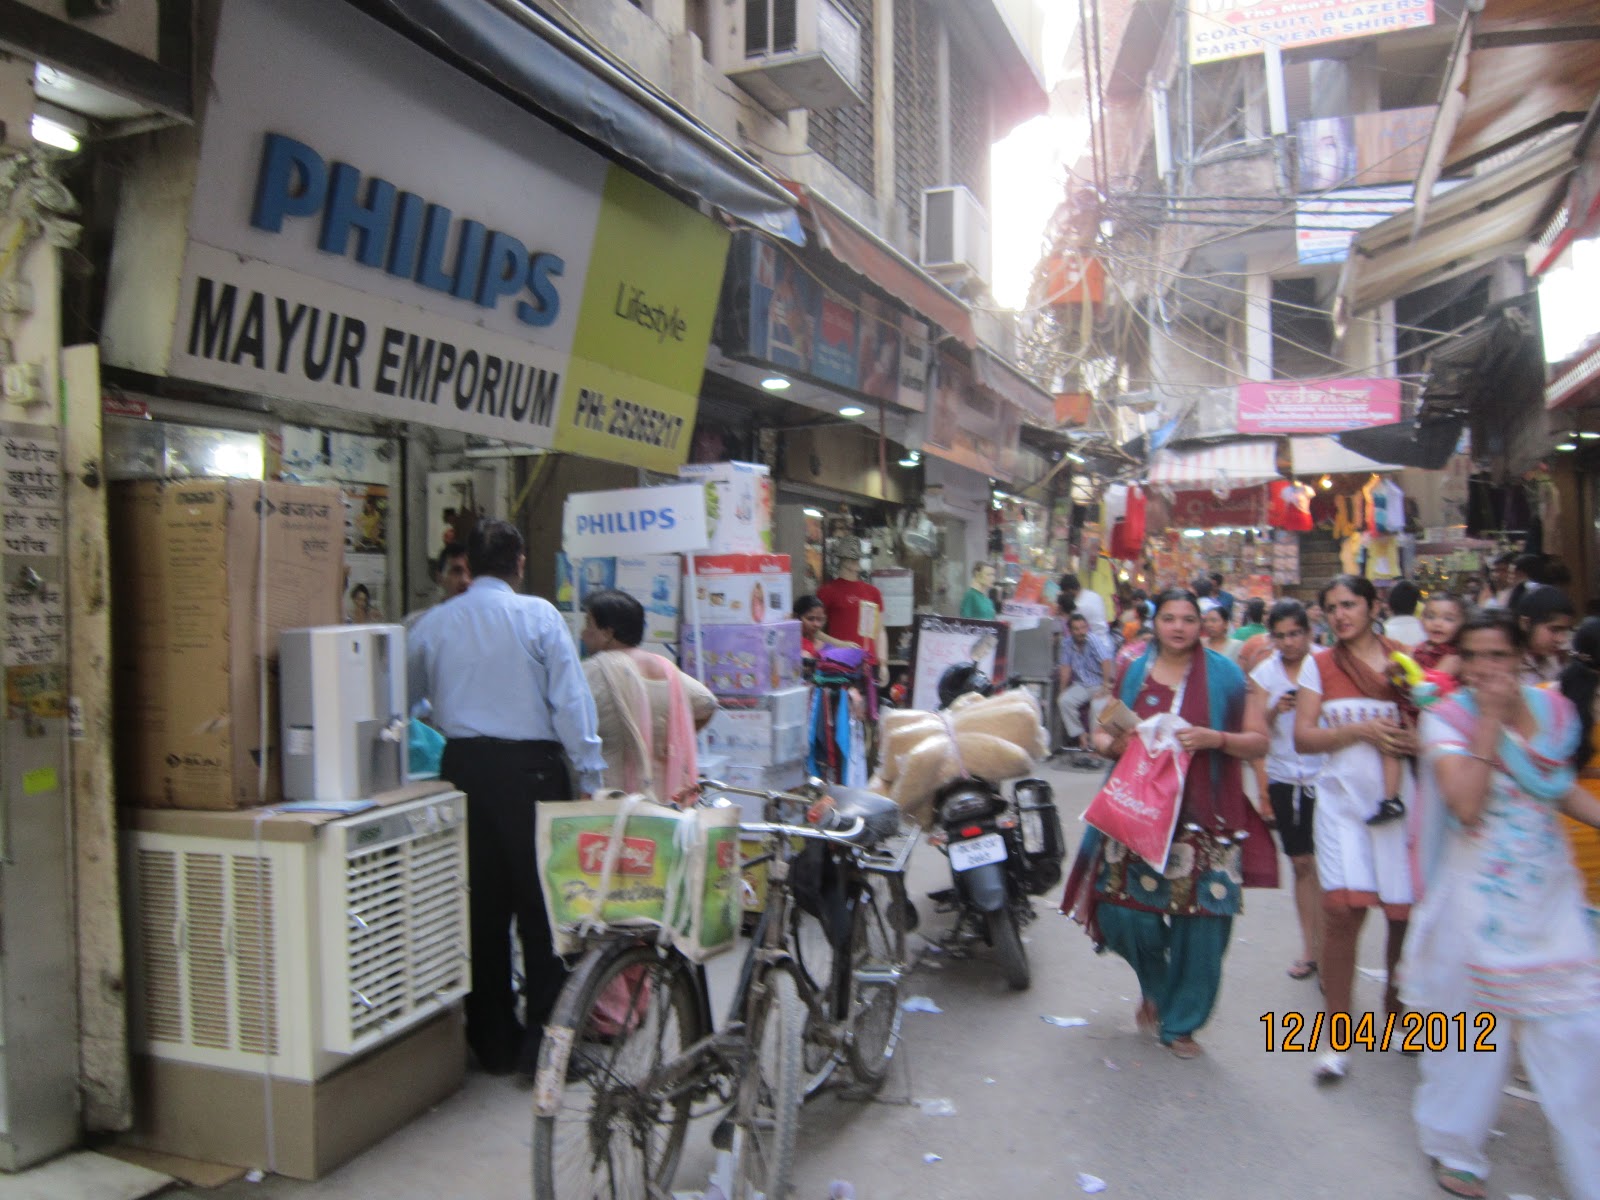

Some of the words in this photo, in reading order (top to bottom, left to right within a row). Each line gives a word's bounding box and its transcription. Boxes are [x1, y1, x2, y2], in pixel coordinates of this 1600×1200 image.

[1196, 25, 1250, 43] COAT
[1322, 0, 1426, 22] BLAZERS
[1196, 39, 1264, 58] PARTY
[1342, 11, 1427, 34] SHIRTS
[250, 131, 566, 328] PHILIPS
[615, 281, 688, 344] Lifestyle
[187, 276, 368, 389] MAYUR
[375, 332, 560, 429] EMPORIUM
[576, 508, 677, 535] PHILIPS
